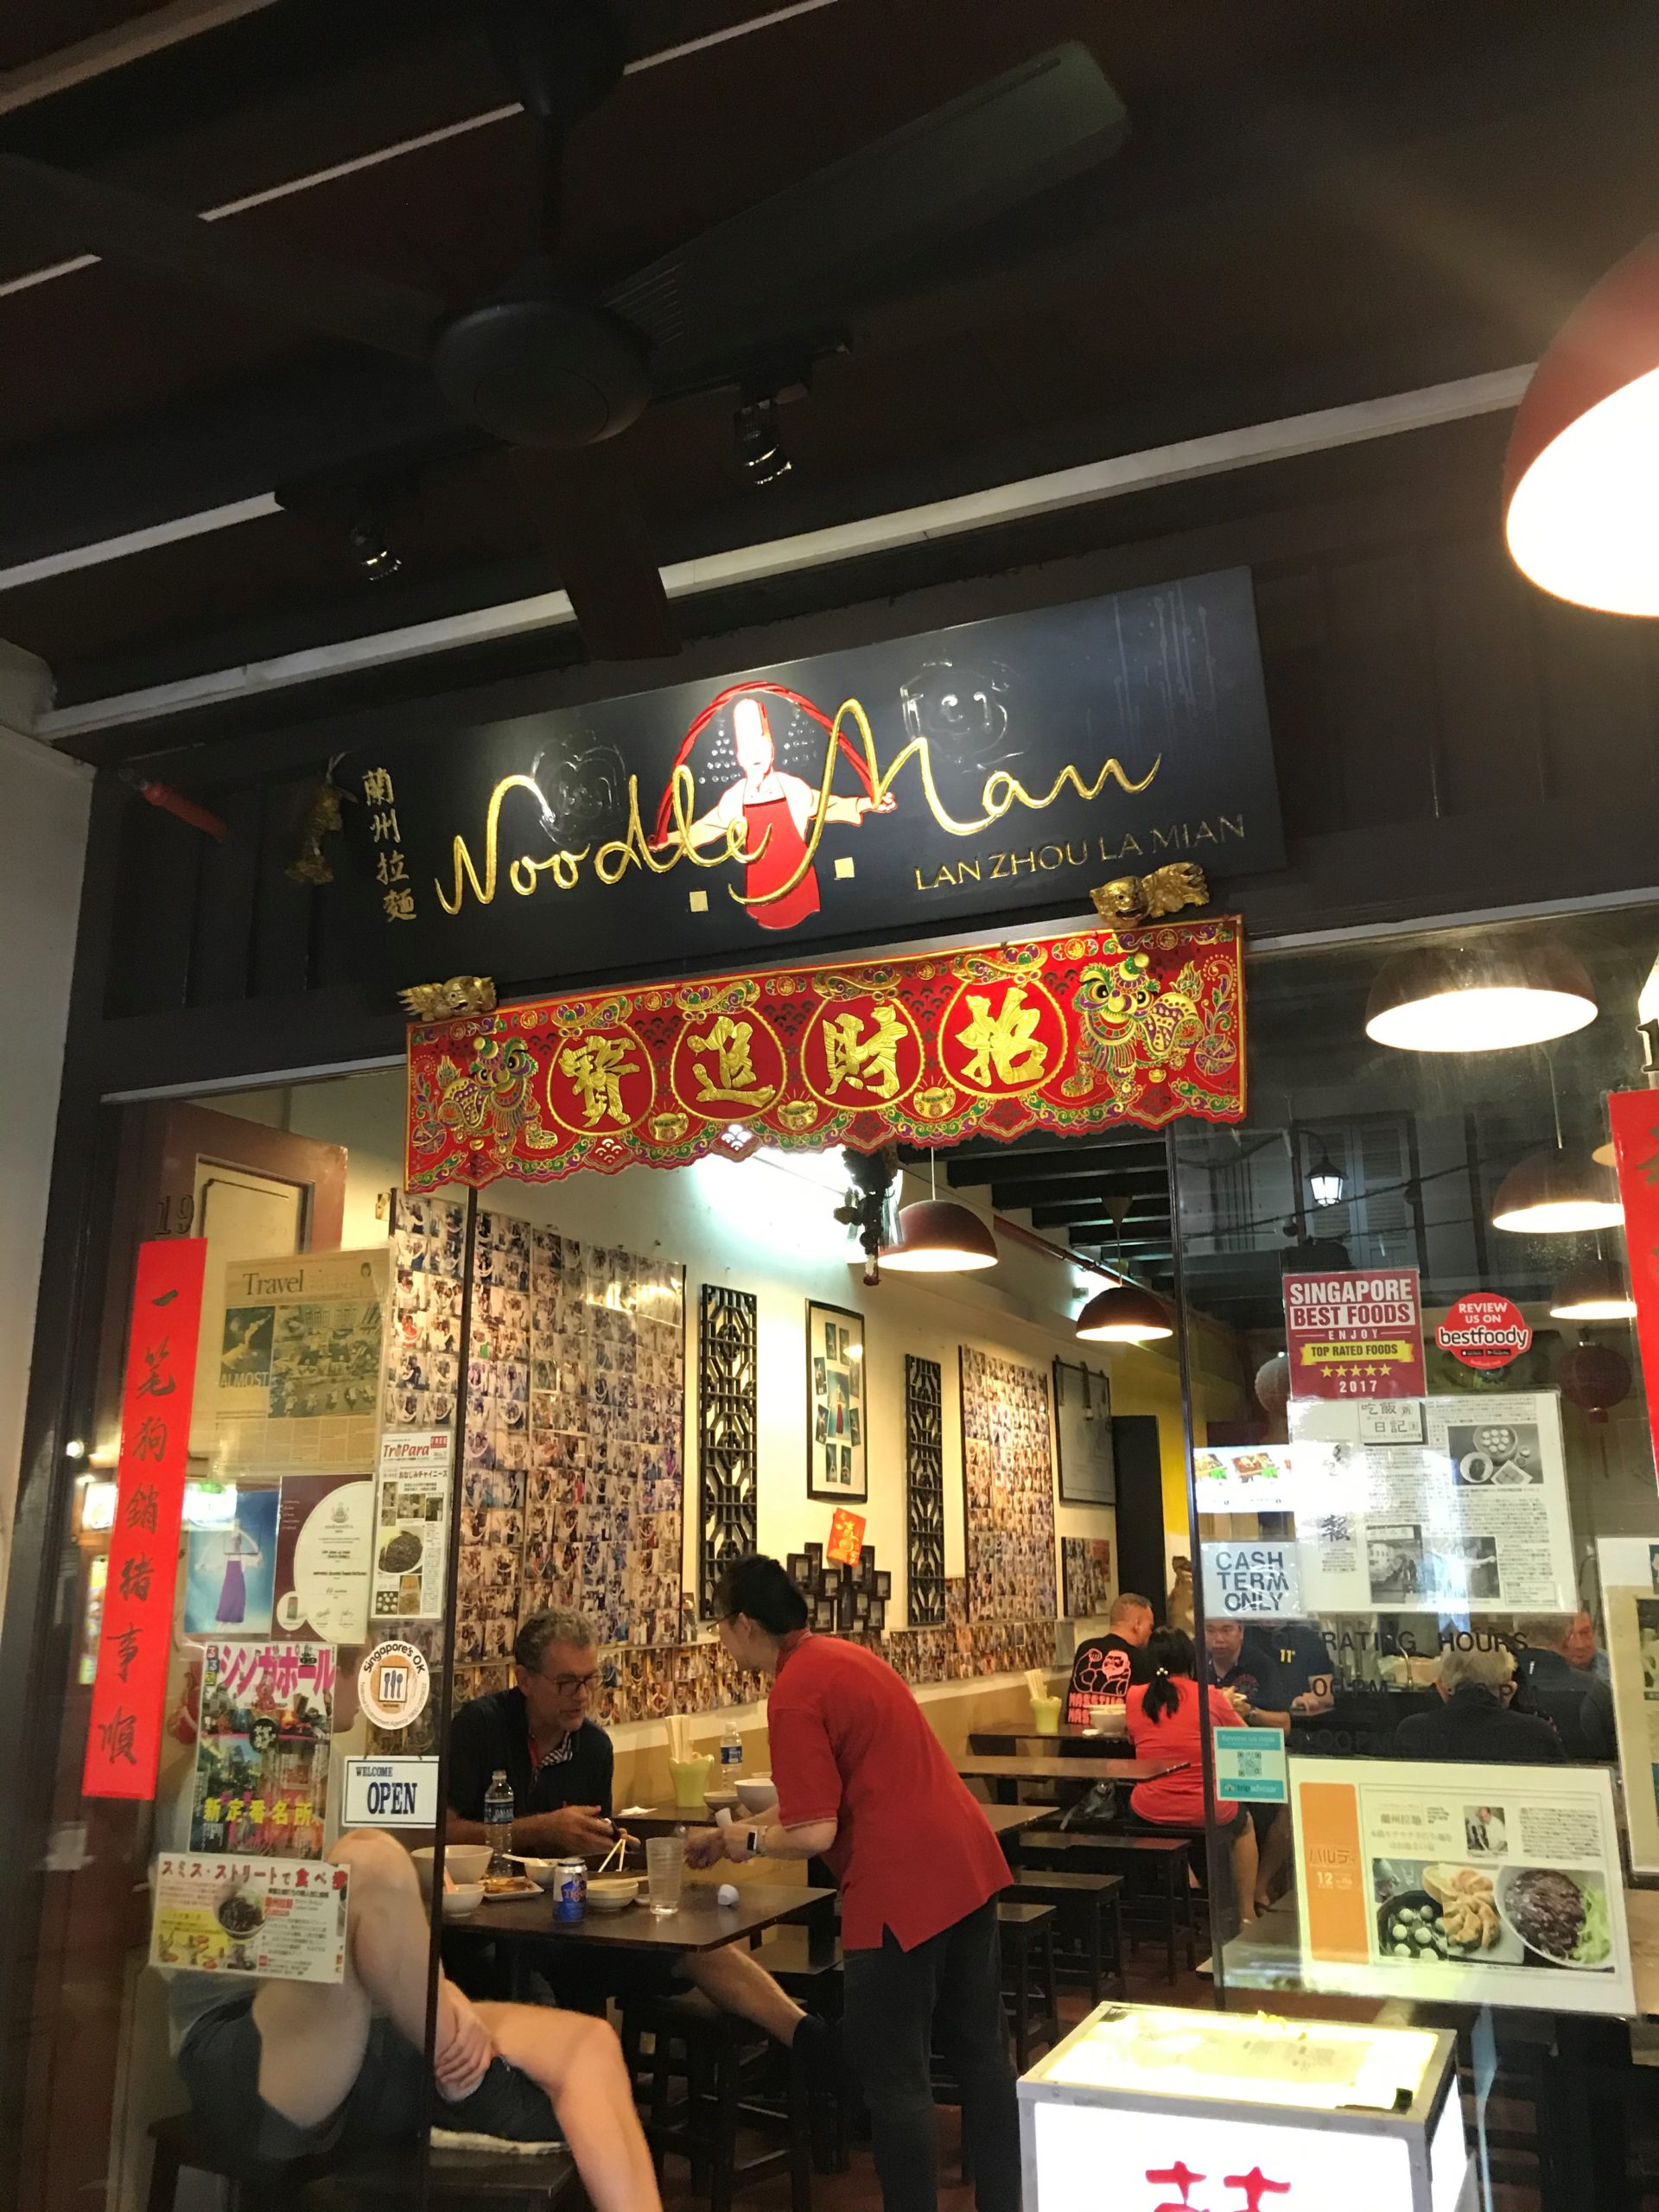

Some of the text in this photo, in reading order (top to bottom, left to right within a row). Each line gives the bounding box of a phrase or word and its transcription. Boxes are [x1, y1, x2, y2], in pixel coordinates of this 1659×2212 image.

[435, 697, 1161, 915] Noodle Man
[913, 813, 1246, 891] LAN ZHOU LA MIAN
[155, 1194, 195, 1235] 19
[243, 1269, 305, 1296] Travel
[1289, 1278, 1414, 1306] SINGAPORE
[1293, 1303, 1411, 1326] BEST FOODS
[1459, 1302, 1508, 1313] REVIEW
[1465, 1314, 1502, 1324] US ON
[1328, 1328, 1379, 1340] ENJOY
[1439, 1325, 1529, 1348] bestfoody
[1311, 1344, 1398, 1357] TOP RATED FOODS
[1339, 1380, 1377, 1393] 2017
[1216, 1551, 1284, 1571] CASH
[1216, 1572, 1290, 1591] TERM
[1224, 1592, 1284, 1612] ONLY
[355, 1766, 393, 1777] WELCOME
[366, 1781, 418, 1815] OPEN
